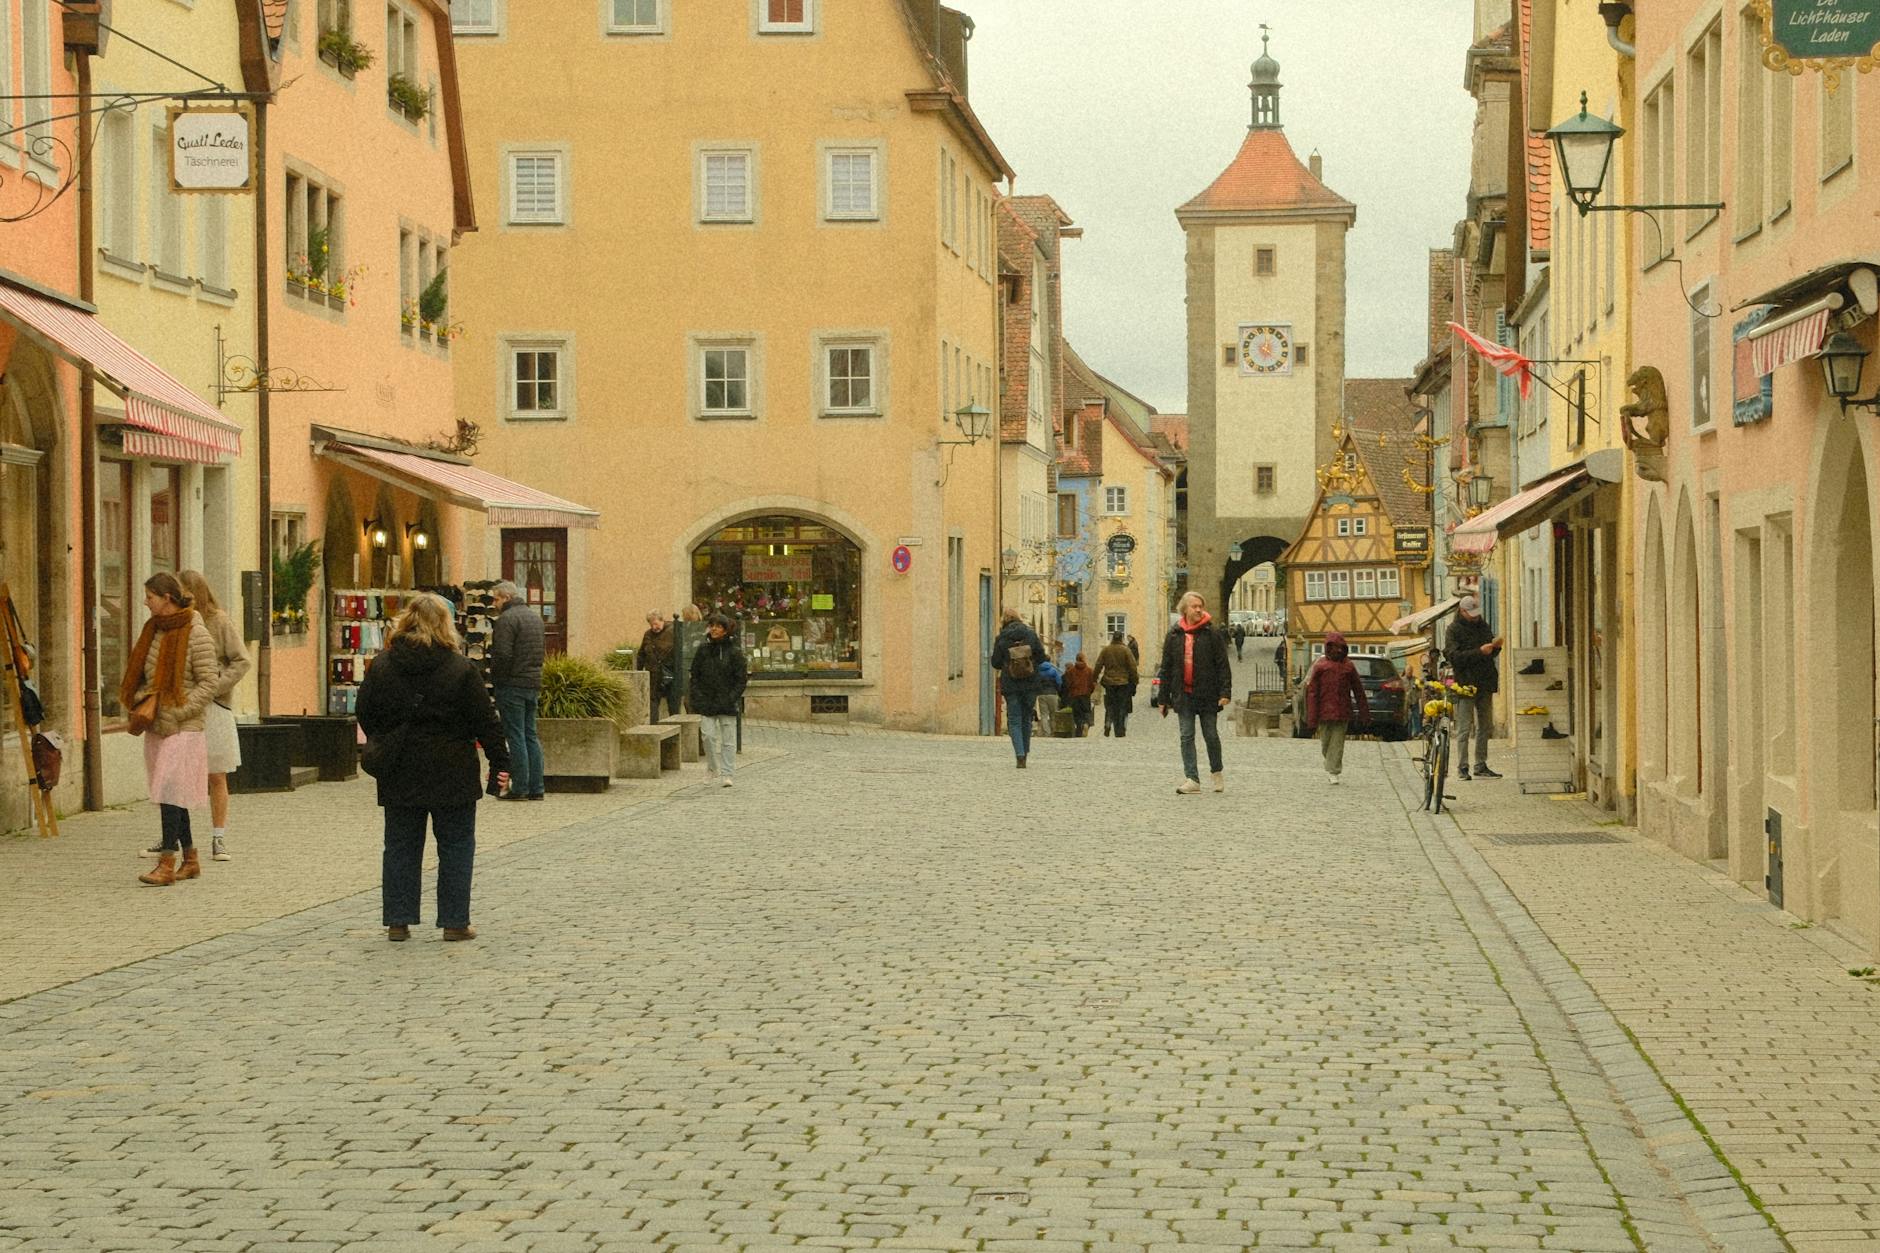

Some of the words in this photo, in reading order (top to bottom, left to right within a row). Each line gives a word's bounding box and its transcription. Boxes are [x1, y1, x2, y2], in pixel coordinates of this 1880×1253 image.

[1789, 10, 1871, 26] Lichthäuser
[1810, 28, 1850, 43] Laden
[177, 133, 208, 151] Gusti
[209, 132, 243, 150] Leder
[184, 155, 239, 168] Taschnerei
